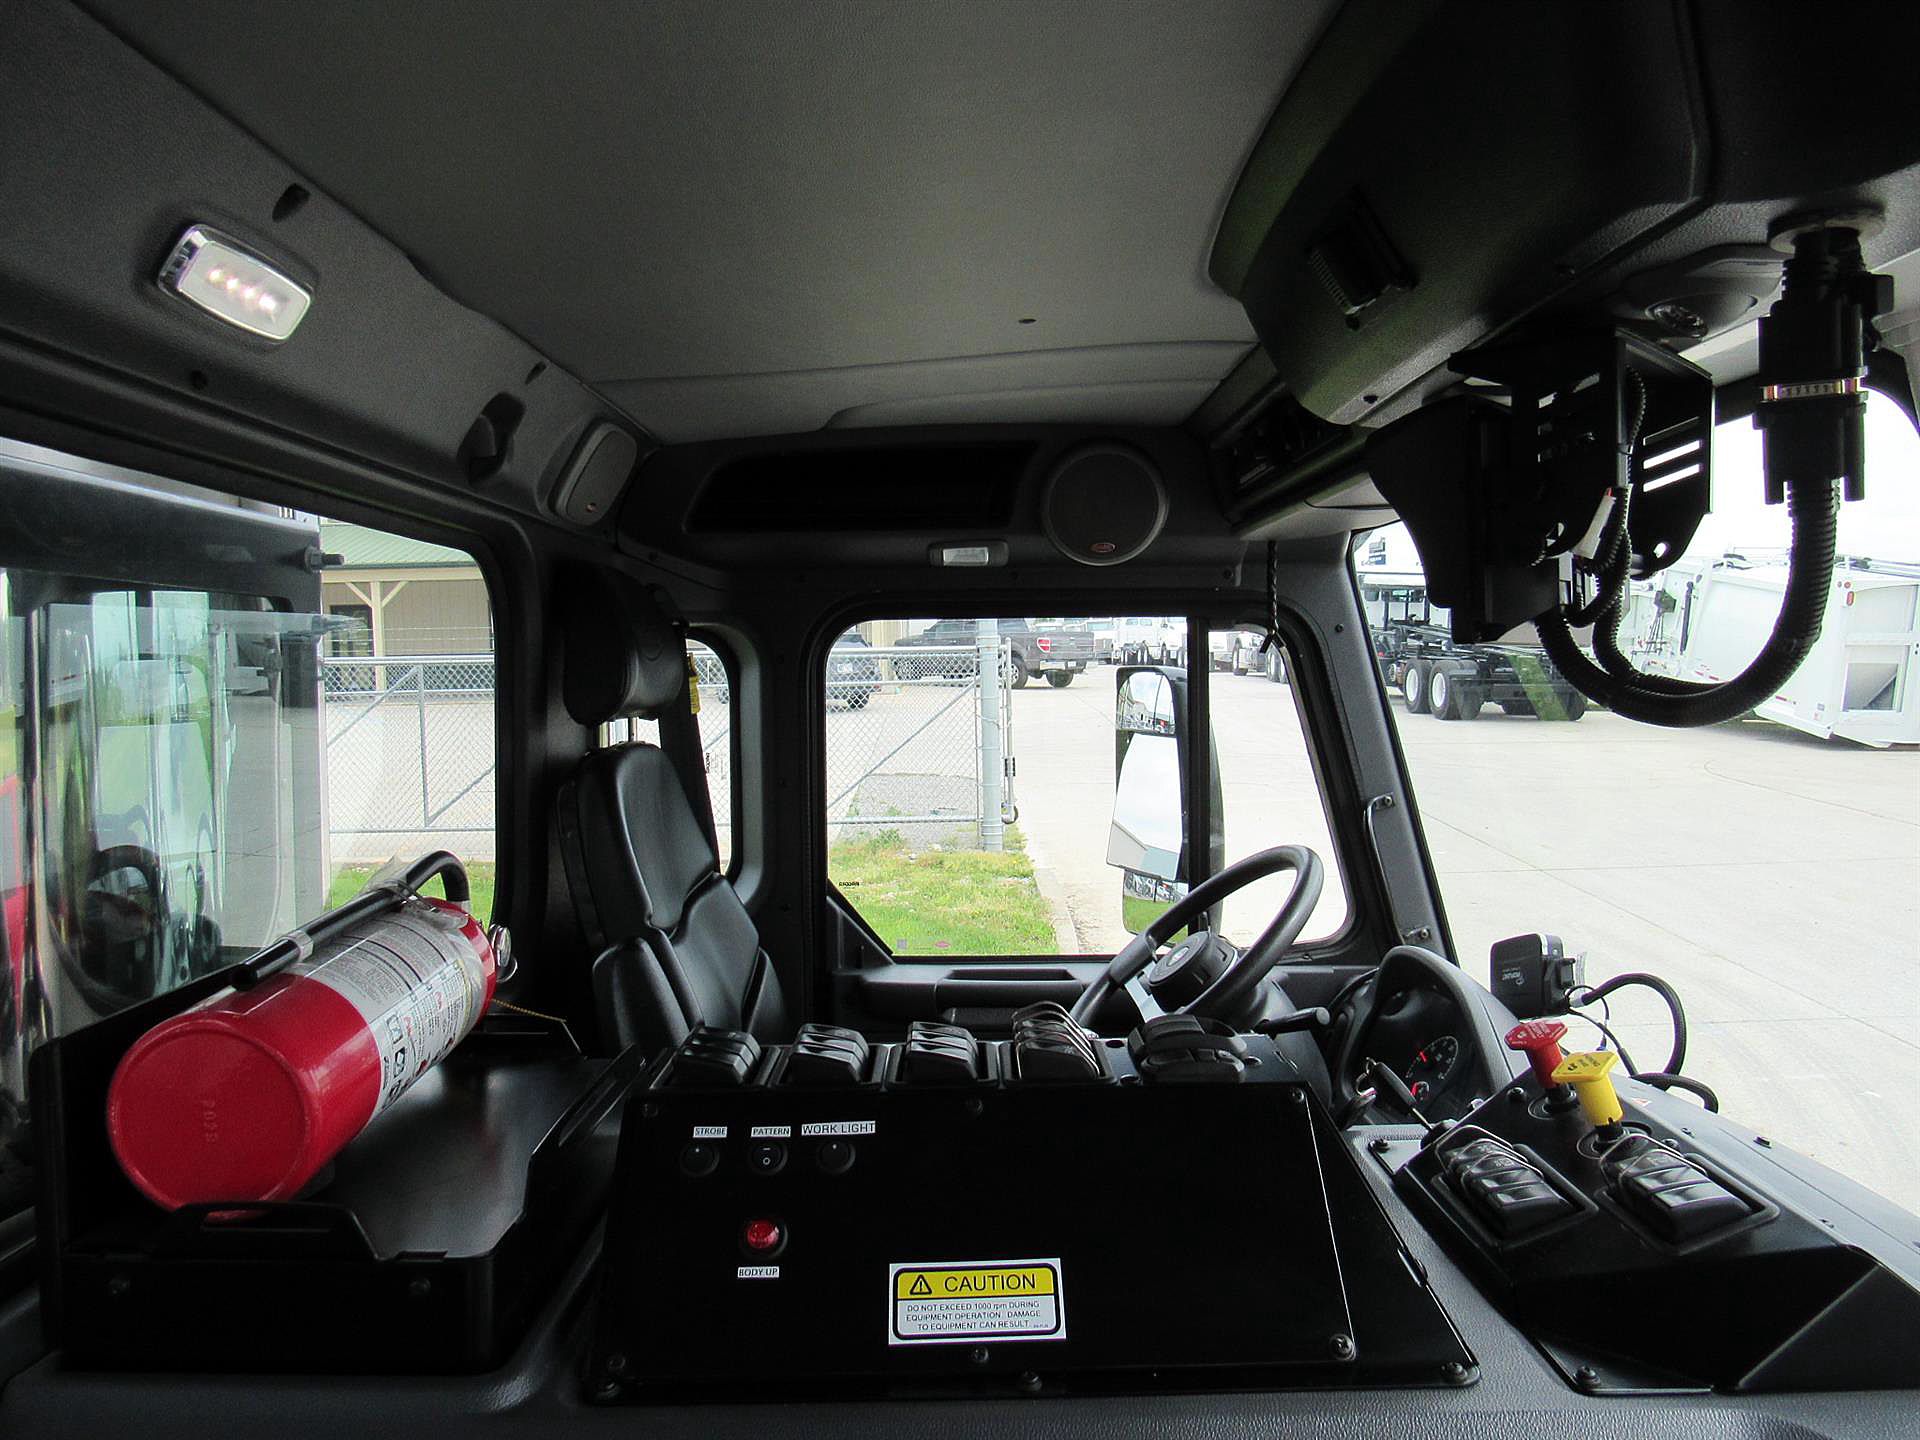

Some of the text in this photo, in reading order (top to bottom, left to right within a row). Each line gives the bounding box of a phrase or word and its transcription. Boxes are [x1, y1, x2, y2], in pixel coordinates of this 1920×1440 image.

[694, 1127, 726, 1136] STROBE
[753, 1127, 790, 1136] PATTERN
[802, 1122, 876, 1134] WORK LIGHT
[765, 1267, 778, 1275] UP
[944, 1274, 1036, 1292] CAUTION
[907, 1304, 920, 1312] DO
[939, 1303, 972, 1311] EXCEED
[974, 1302, 992, 1310] 1000
[906, 1313, 953, 1321] EQUIPMENT
[1007, 1310, 1041, 1318] DAMAGE
[917, 1323, 929, 1331] TO
[930, 1322, 977, 1330] EQUIPMENT
[979, 1321, 998, 1329] CAN
